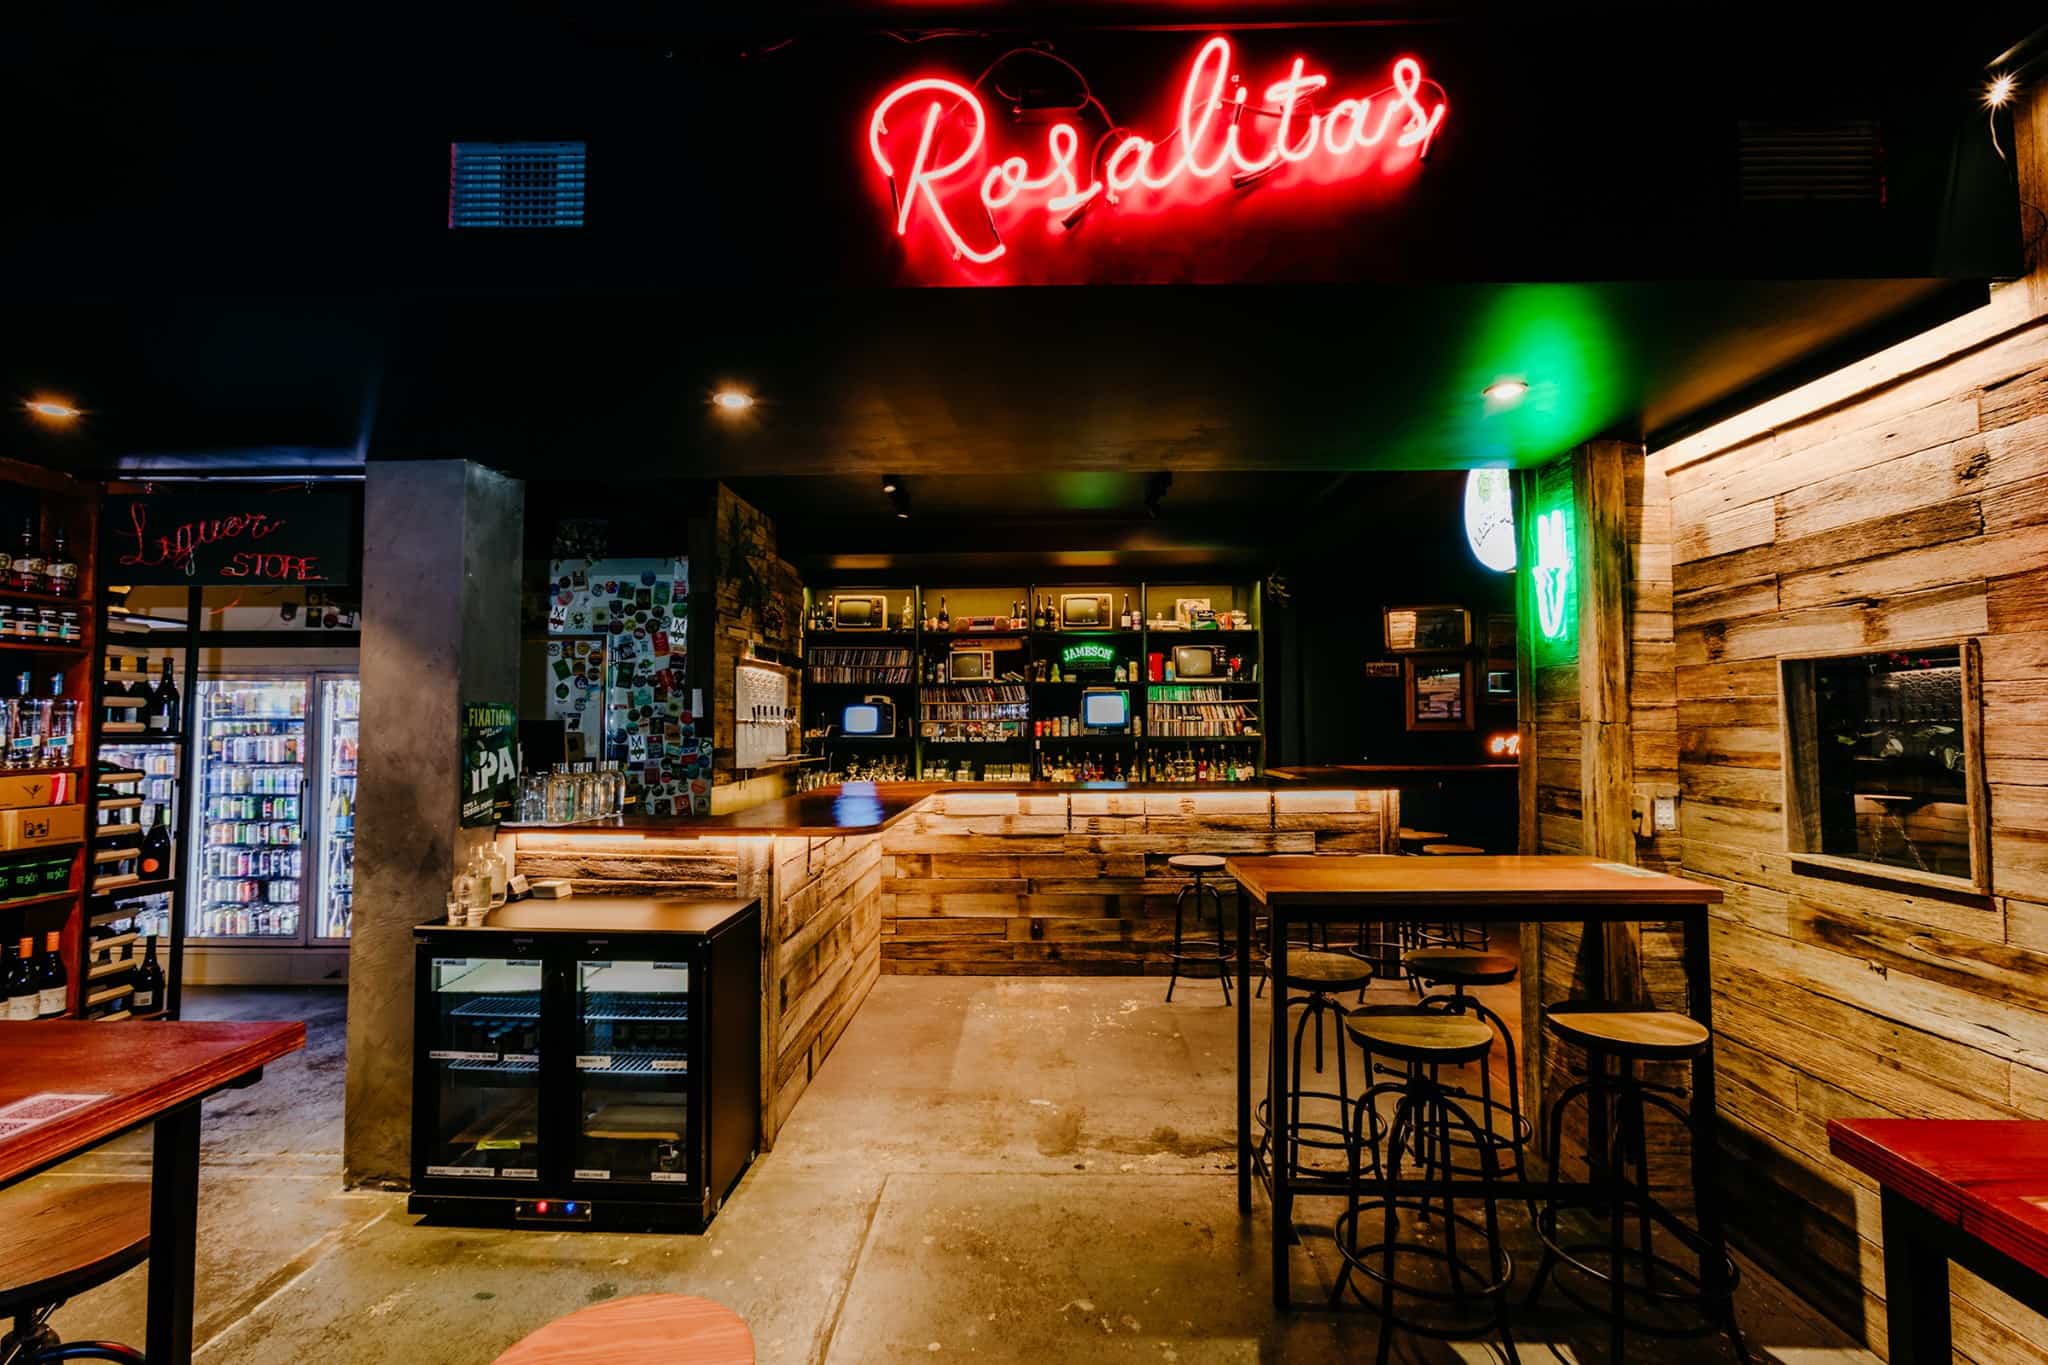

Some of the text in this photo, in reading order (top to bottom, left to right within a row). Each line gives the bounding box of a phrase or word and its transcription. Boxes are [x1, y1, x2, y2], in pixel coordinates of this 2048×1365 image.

[869, 36, 1447, 264] Rosalitas
[219, 552, 328, 580] STORE
[1063, 646, 1113, 662] JAMESON
[468, 708, 512, 728] FIXATION
